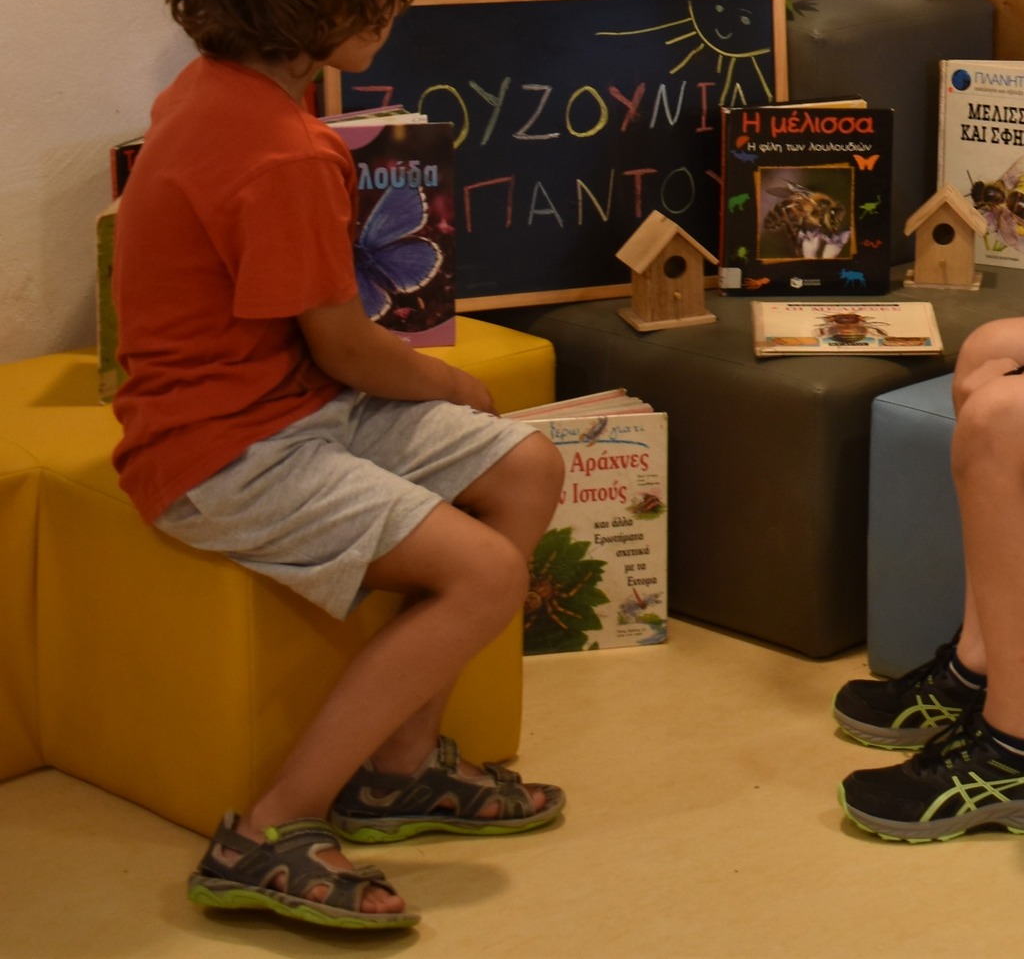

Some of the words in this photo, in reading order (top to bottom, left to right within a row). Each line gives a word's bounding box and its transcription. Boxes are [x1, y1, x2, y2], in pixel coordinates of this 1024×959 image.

[742, 112, 761, 134] Η
[770, 110, 875, 138] μέλισσα
[960, 123, 988, 142] ΚΑΙ
[747, 142, 757, 152] Η
[570, 450, 649, 477] Αράχνες
[572, 479, 628, 505] Ιστούς
